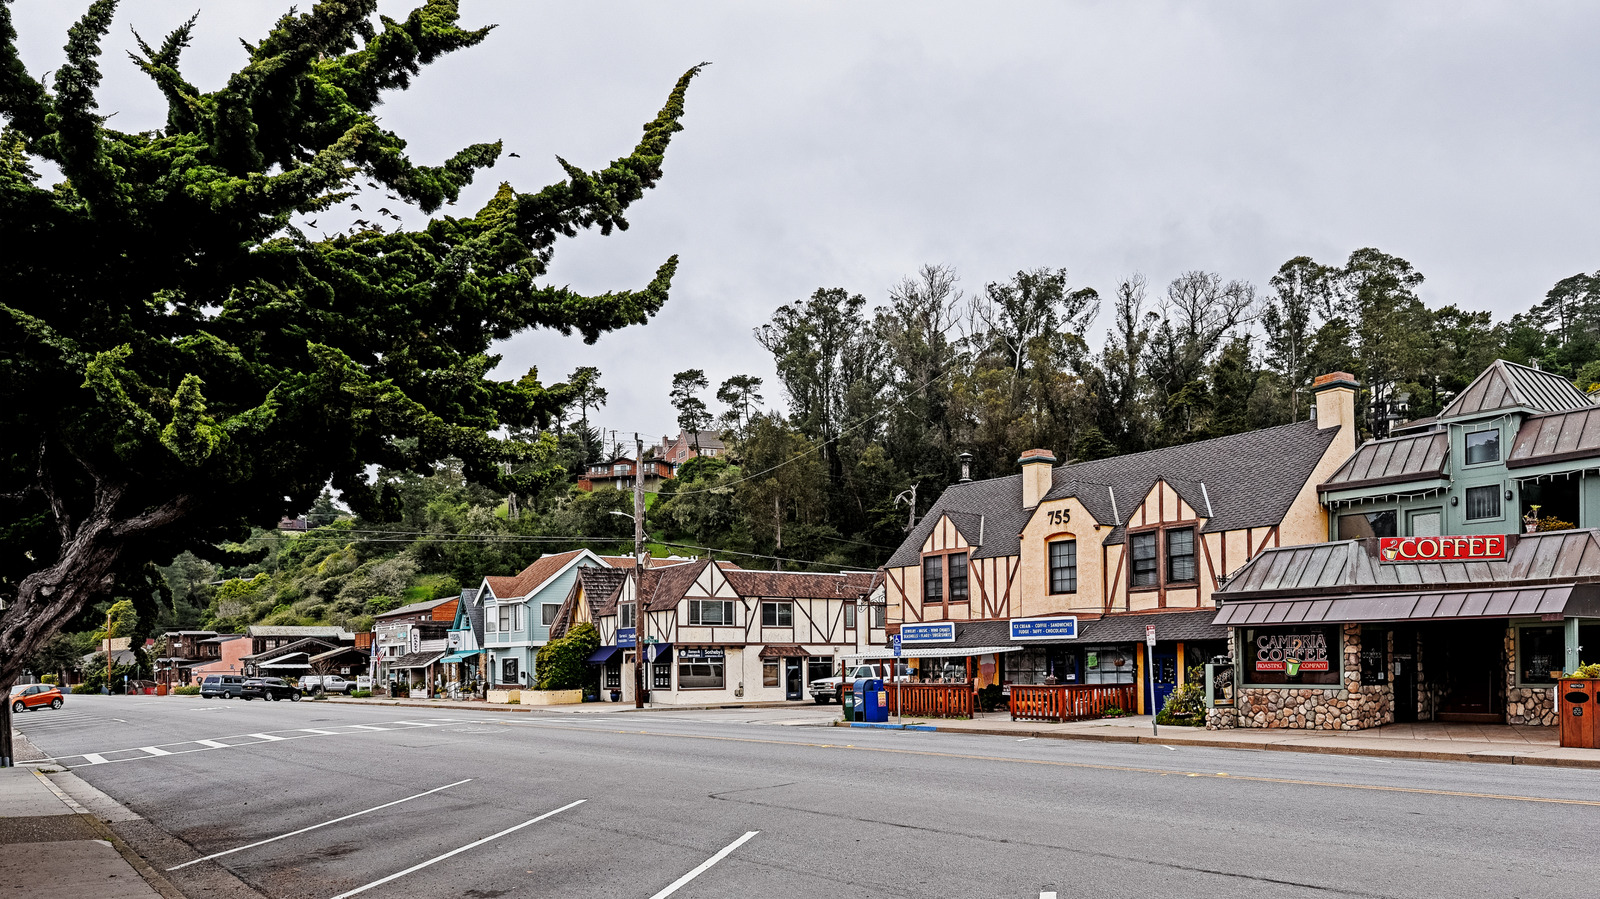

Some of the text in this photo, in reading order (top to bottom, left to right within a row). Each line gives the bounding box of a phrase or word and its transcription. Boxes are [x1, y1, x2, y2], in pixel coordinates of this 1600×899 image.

[1047, 509, 1071, 525] 755
[1398, 537, 1502, 559] COFFEE
[1256, 634, 1328, 649] CAMBRIA
[1256, 648, 1328, 661] COFFEE
[1257, 661, 1283, 669] ROASTING
